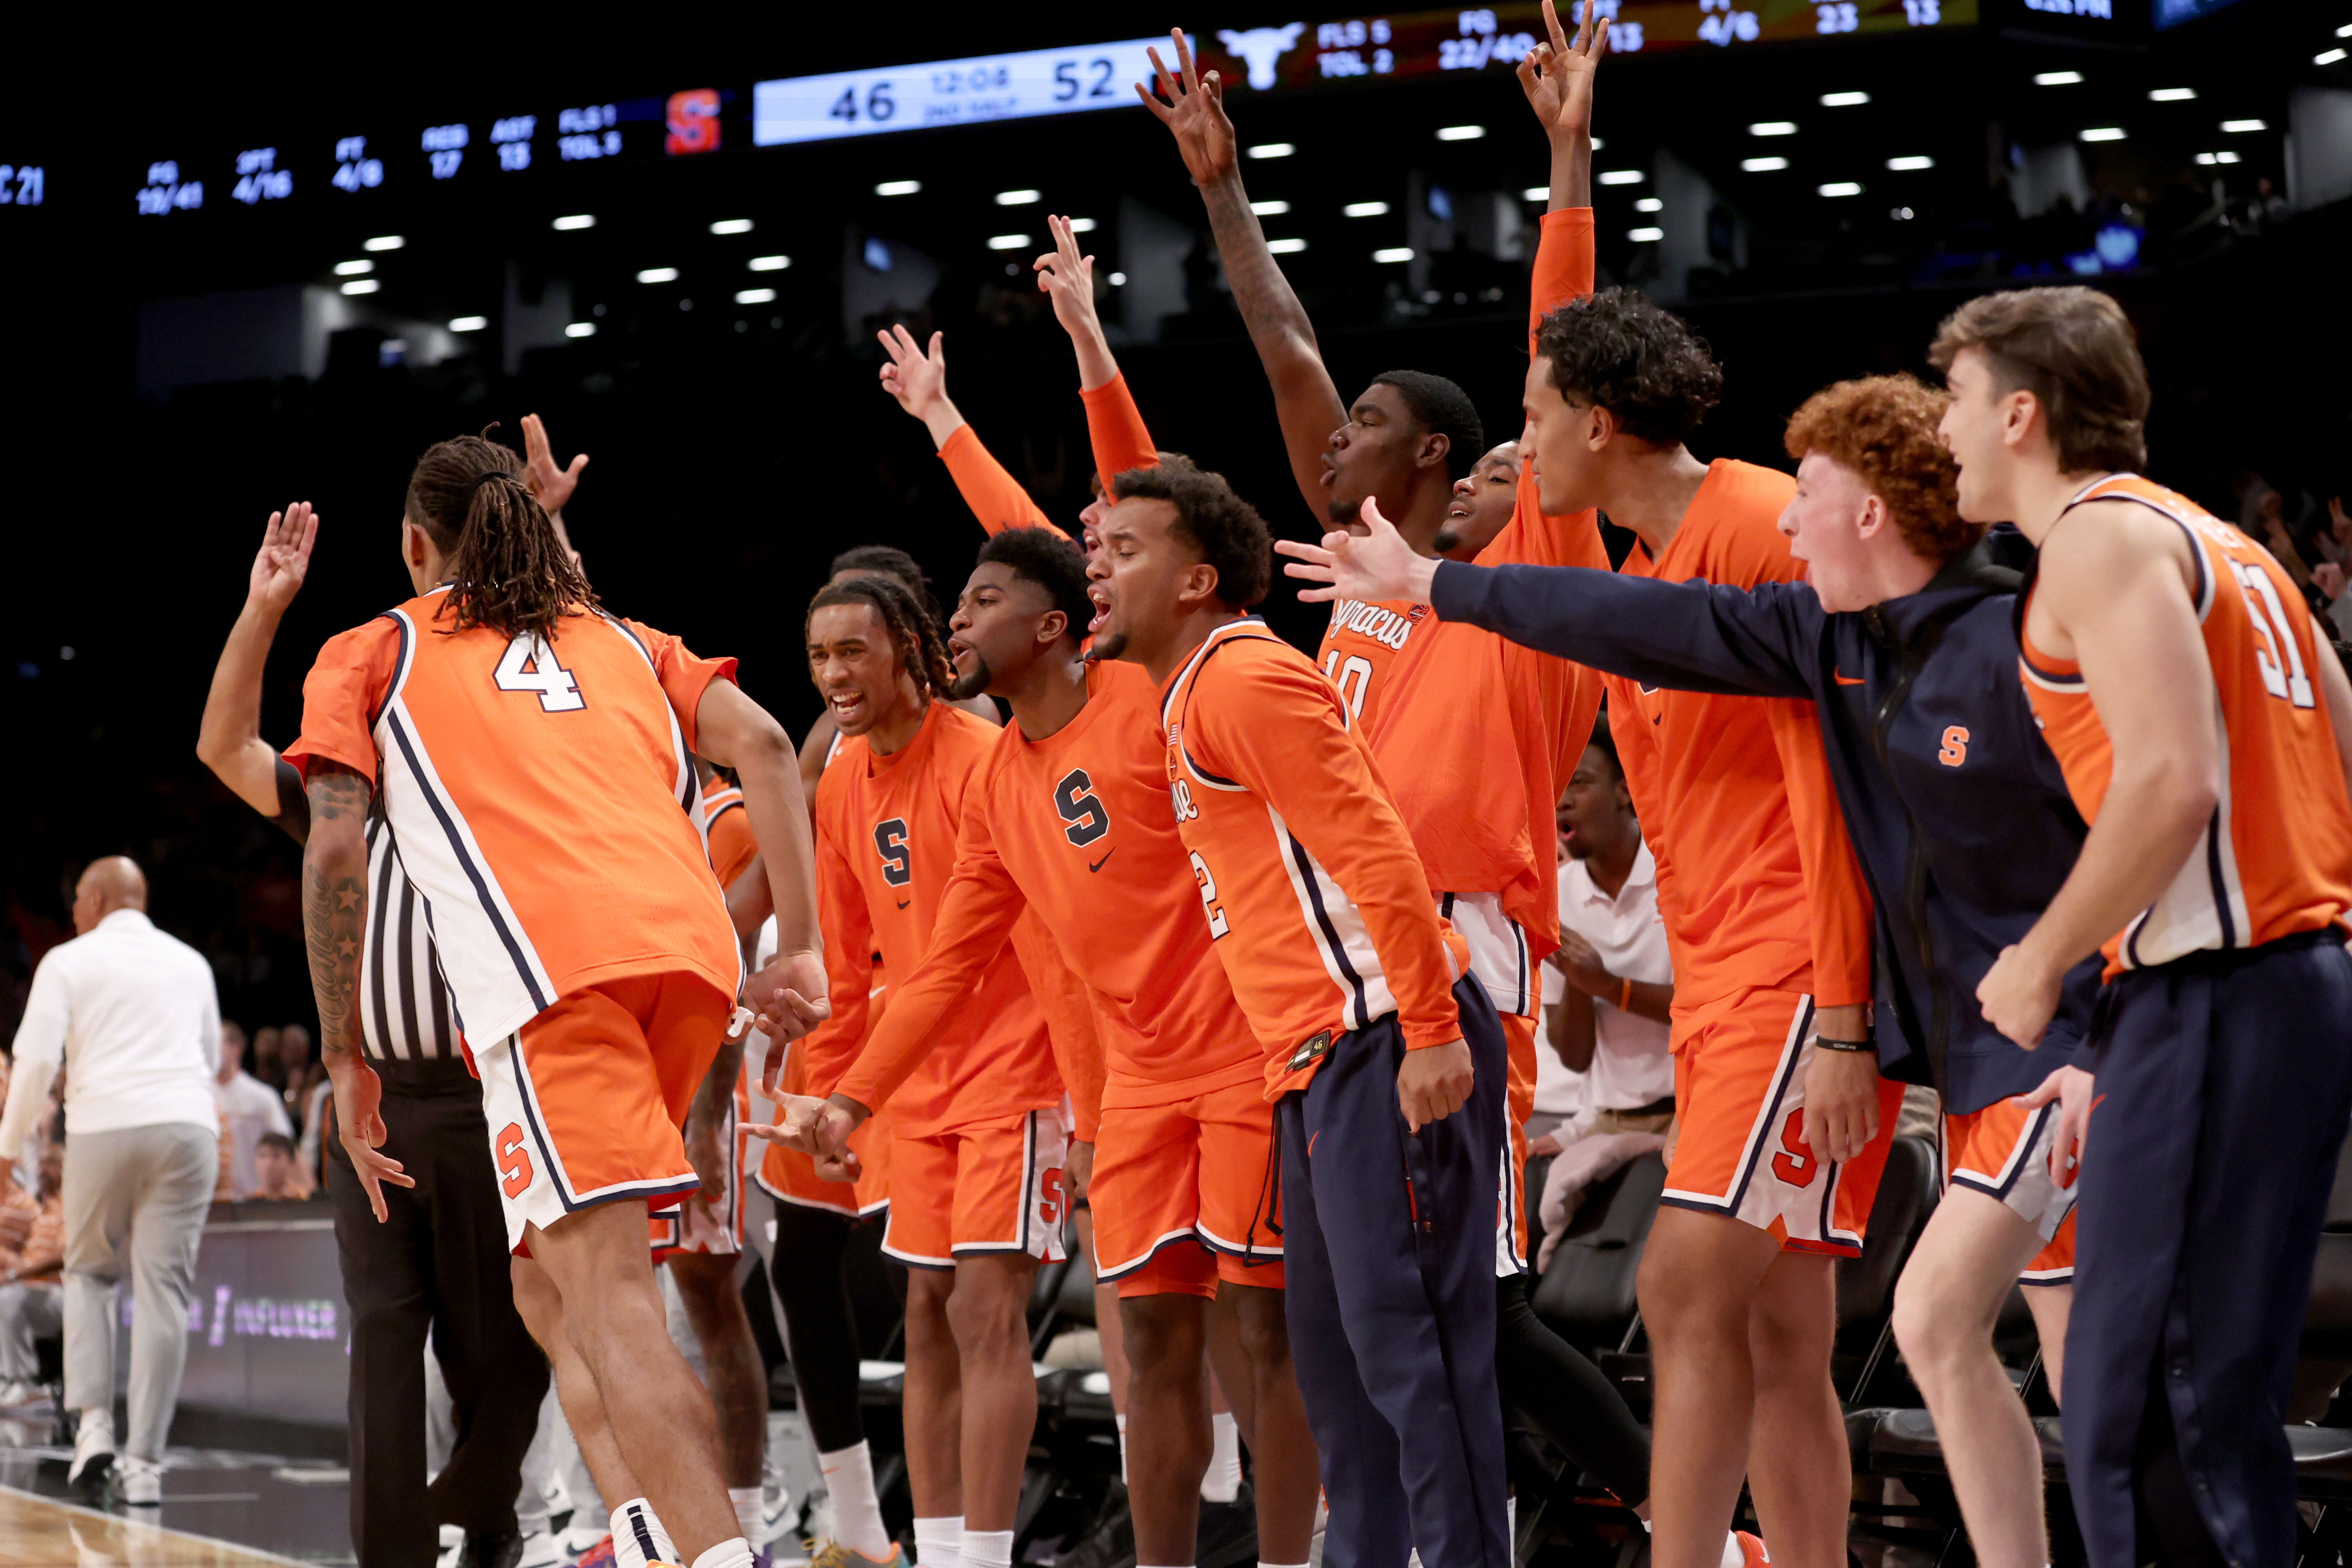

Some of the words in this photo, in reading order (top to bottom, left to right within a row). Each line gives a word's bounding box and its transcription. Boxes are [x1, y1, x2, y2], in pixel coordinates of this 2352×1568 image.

[1317, 20, 1367, 49] FLS
[1370, 19, 1392, 45] 5
[1459, 9, 1497, 37] FG
[1697, 10, 1760, 46] 4/6
[932, 66, 1010, 94] 12:08
[1052, 59, 1116, 103] 52
[1316, 50, 1370, 78] TOL
[665, 89, 722, 155] S
[829, 82, 896, 124] 46
[16, 165, 44, 205] 21
[1330, 598, 1413, 650] yracus
[2222, 551, 2316, 709] 51
[492, 629, 587, 713] 4
[1938, 725, 1970, 767] S
[1053, 767, 1110, 848] S
[873, 817, 910, 887] S
[1189, 849, 1230, 942] 2
[1314, 1040, 1323, 1051] 46
[495, 1122, 534, 1200] S
[1039, 1167, 1063, 1224] S
